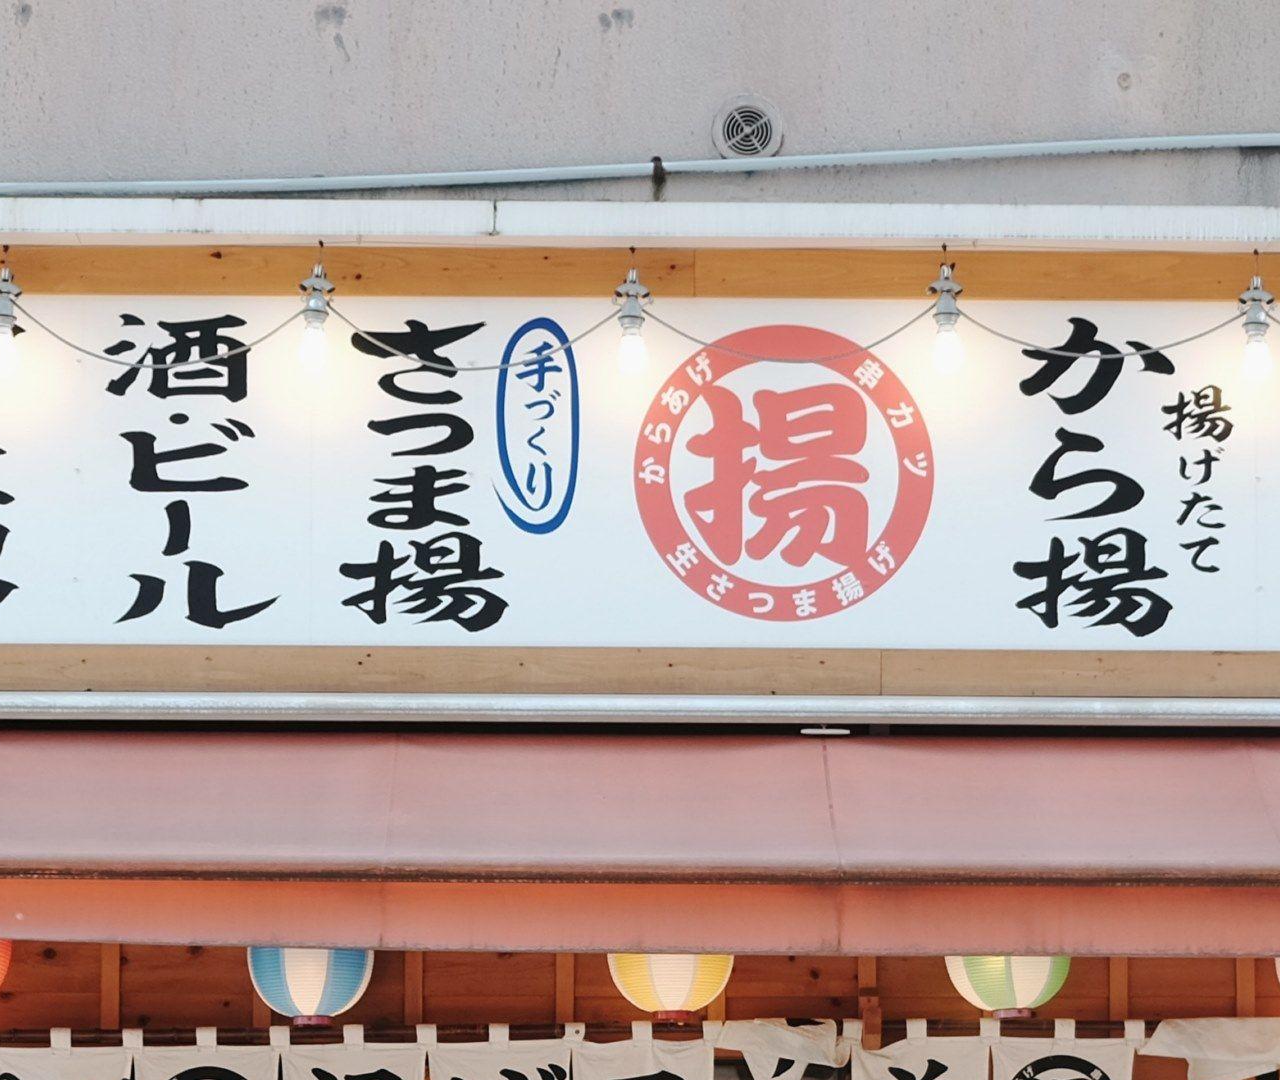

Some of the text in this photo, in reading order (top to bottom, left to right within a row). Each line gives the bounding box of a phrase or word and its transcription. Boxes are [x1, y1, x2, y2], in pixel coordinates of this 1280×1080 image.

[102, 312, 283, 629] 酒・ビール
[337, 319, 509, 634] さつま揚
[515, 339, 561, 514] 手づくり
[638, 351, 714, 485] からあげ
[683, 382, 870, 568] 揚
[855, 356, 929, 478] 串カツ
[1011, 316, 1177, 637] から揚
[1161, 384, 1234, 574] 揚げたて
[665, 541, 898, 618] 生さつま揚げ
